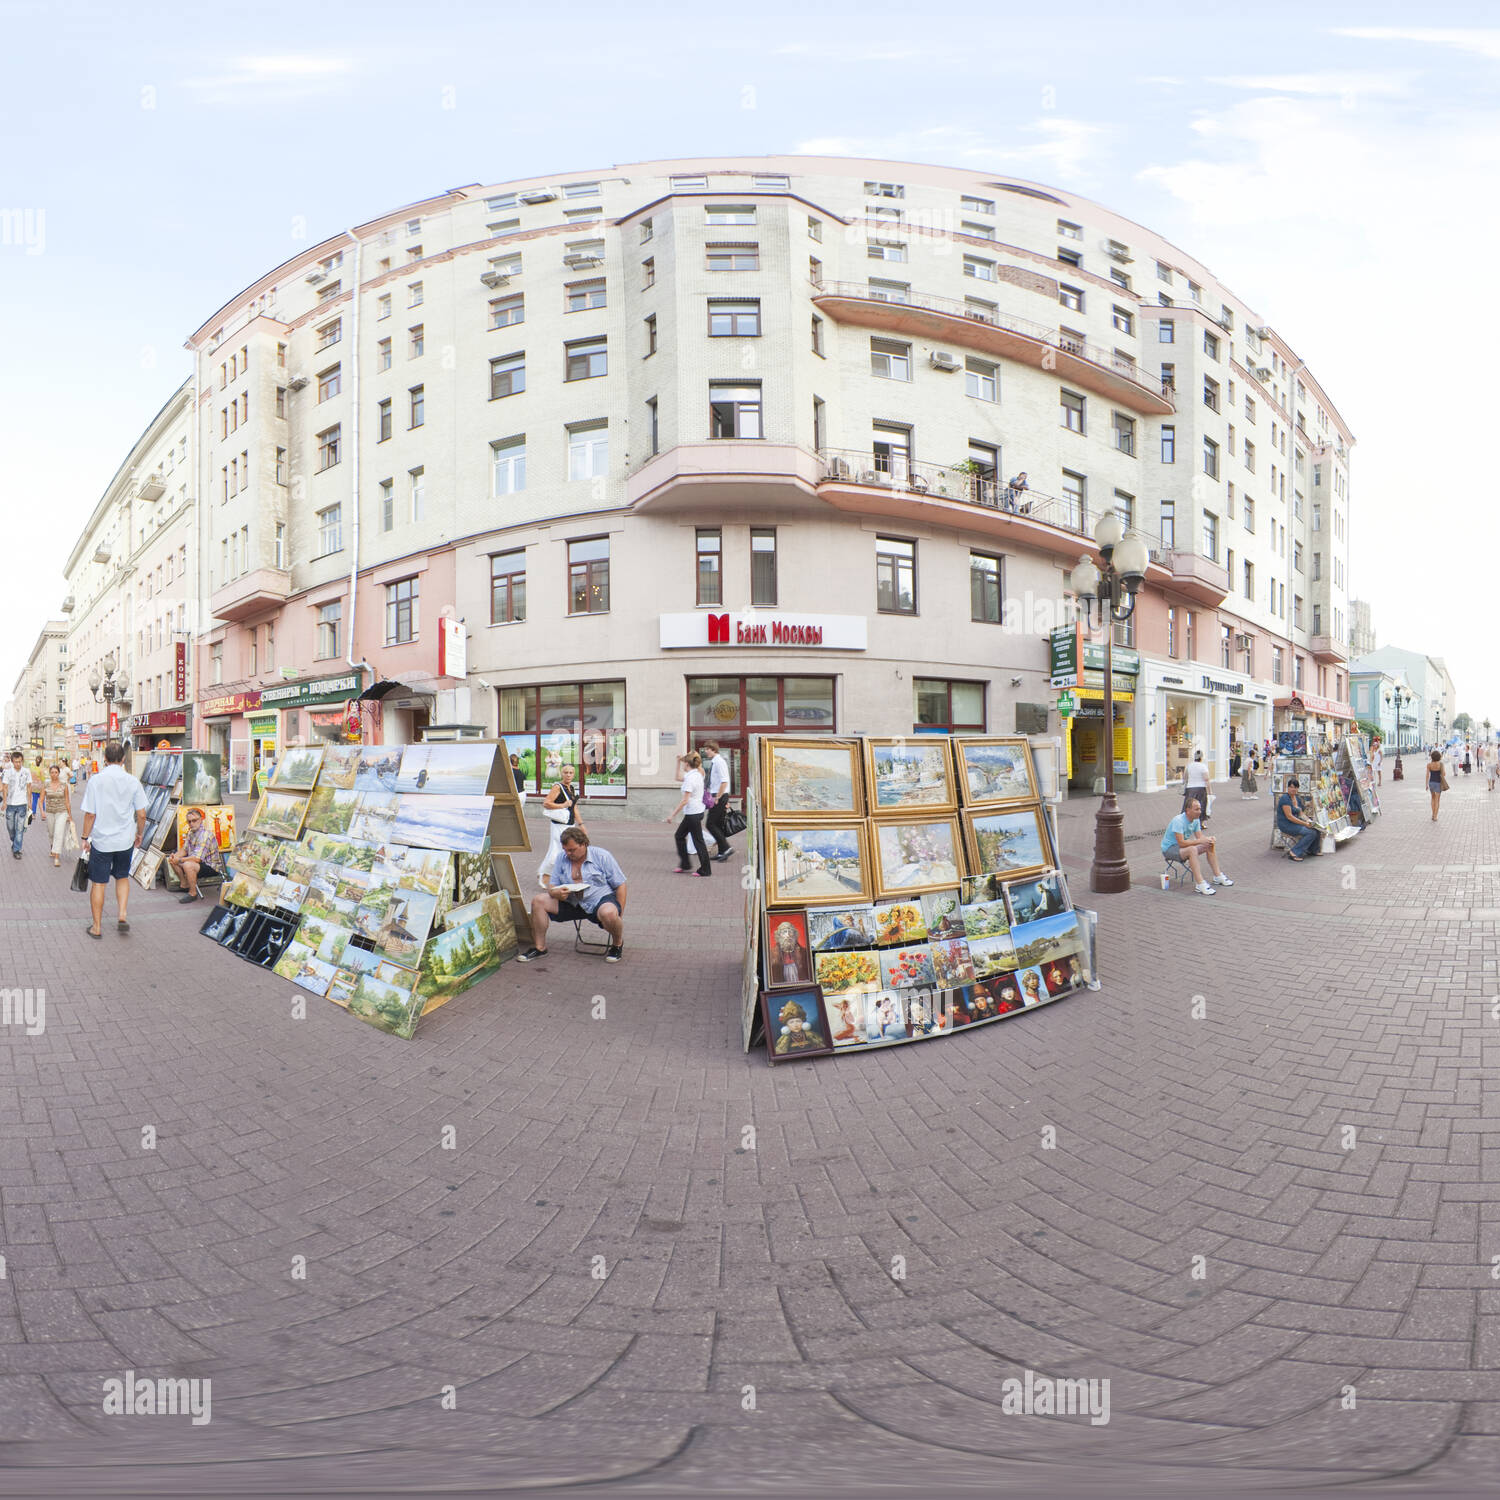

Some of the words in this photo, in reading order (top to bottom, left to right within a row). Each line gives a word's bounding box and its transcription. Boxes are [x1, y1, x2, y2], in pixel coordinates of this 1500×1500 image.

[737, 621, 767, 644] Банк
[772, 621, 822, 644] Москвы
[309, 677, 356, 695] ПОДАРКИ
